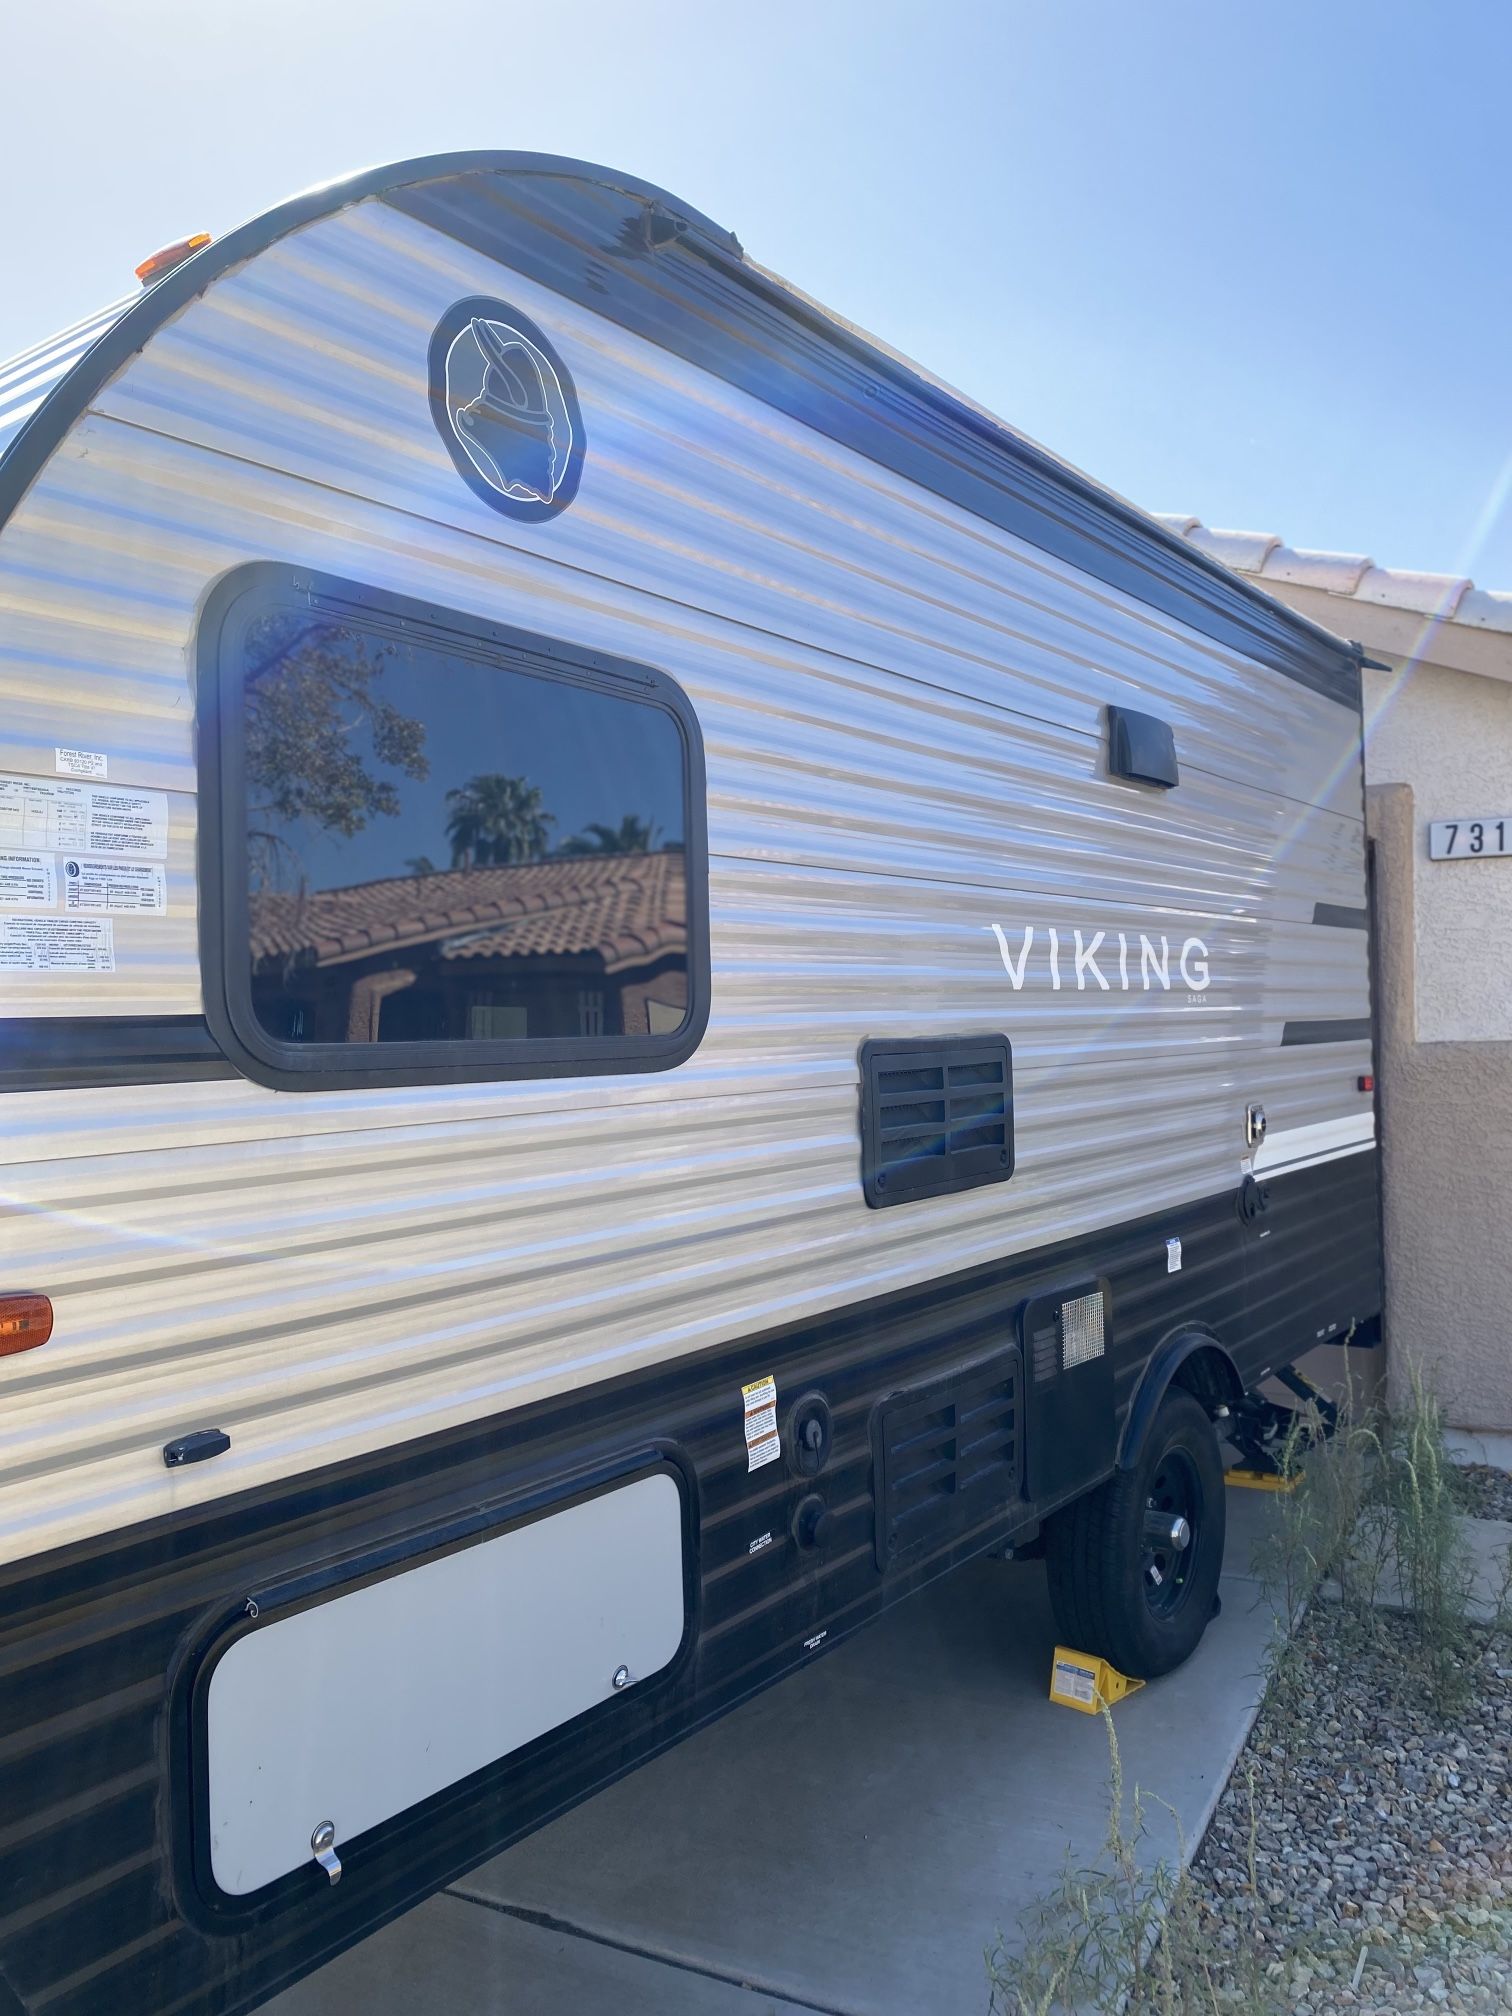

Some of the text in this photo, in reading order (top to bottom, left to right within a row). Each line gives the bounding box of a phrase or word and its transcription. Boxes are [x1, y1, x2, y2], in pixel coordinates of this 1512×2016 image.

[60, 750, 76, 758] Forest
[1445, 821, 1504, 855] 731
[991, 923, 1211, 991] VIKING
[1188, 994, 1207, 1004] SAGA
